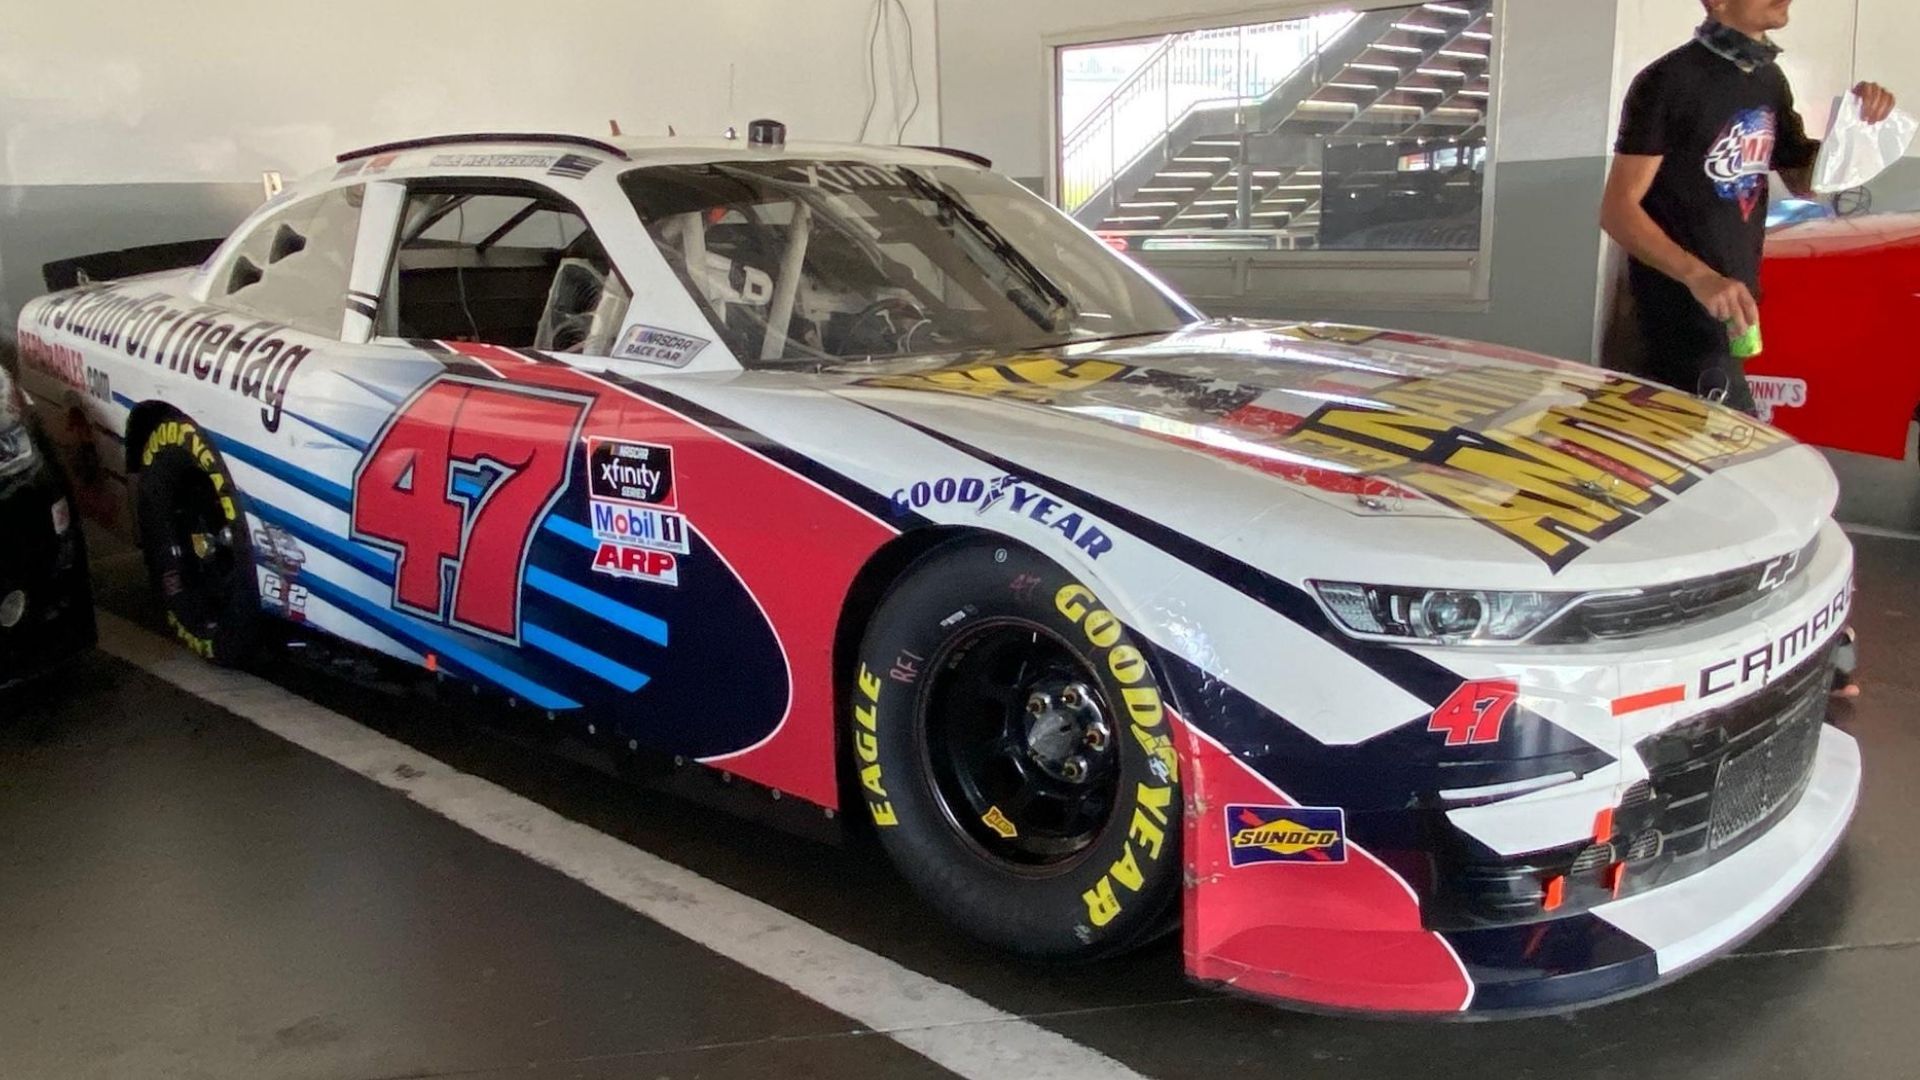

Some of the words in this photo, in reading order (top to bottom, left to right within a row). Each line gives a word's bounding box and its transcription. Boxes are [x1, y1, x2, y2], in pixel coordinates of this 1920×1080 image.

[625, 343, 651, 356] RACE
[655, 348, 682, 361] CAR
[647, 331, 693, 351] NASCAR
[601, 457, 661, 495] xfinity
[352, 375, 596, 645] 47
[595, 504, 656, 539] Mobil
[664, 516, 678, 542] 1
[595, 543, 674, 576] ARP
[1428, 676, 1519, 746] 47
[855, 661, 899, 826] EAGLE
[1238, 831, 1335, 845] SUNOCO
